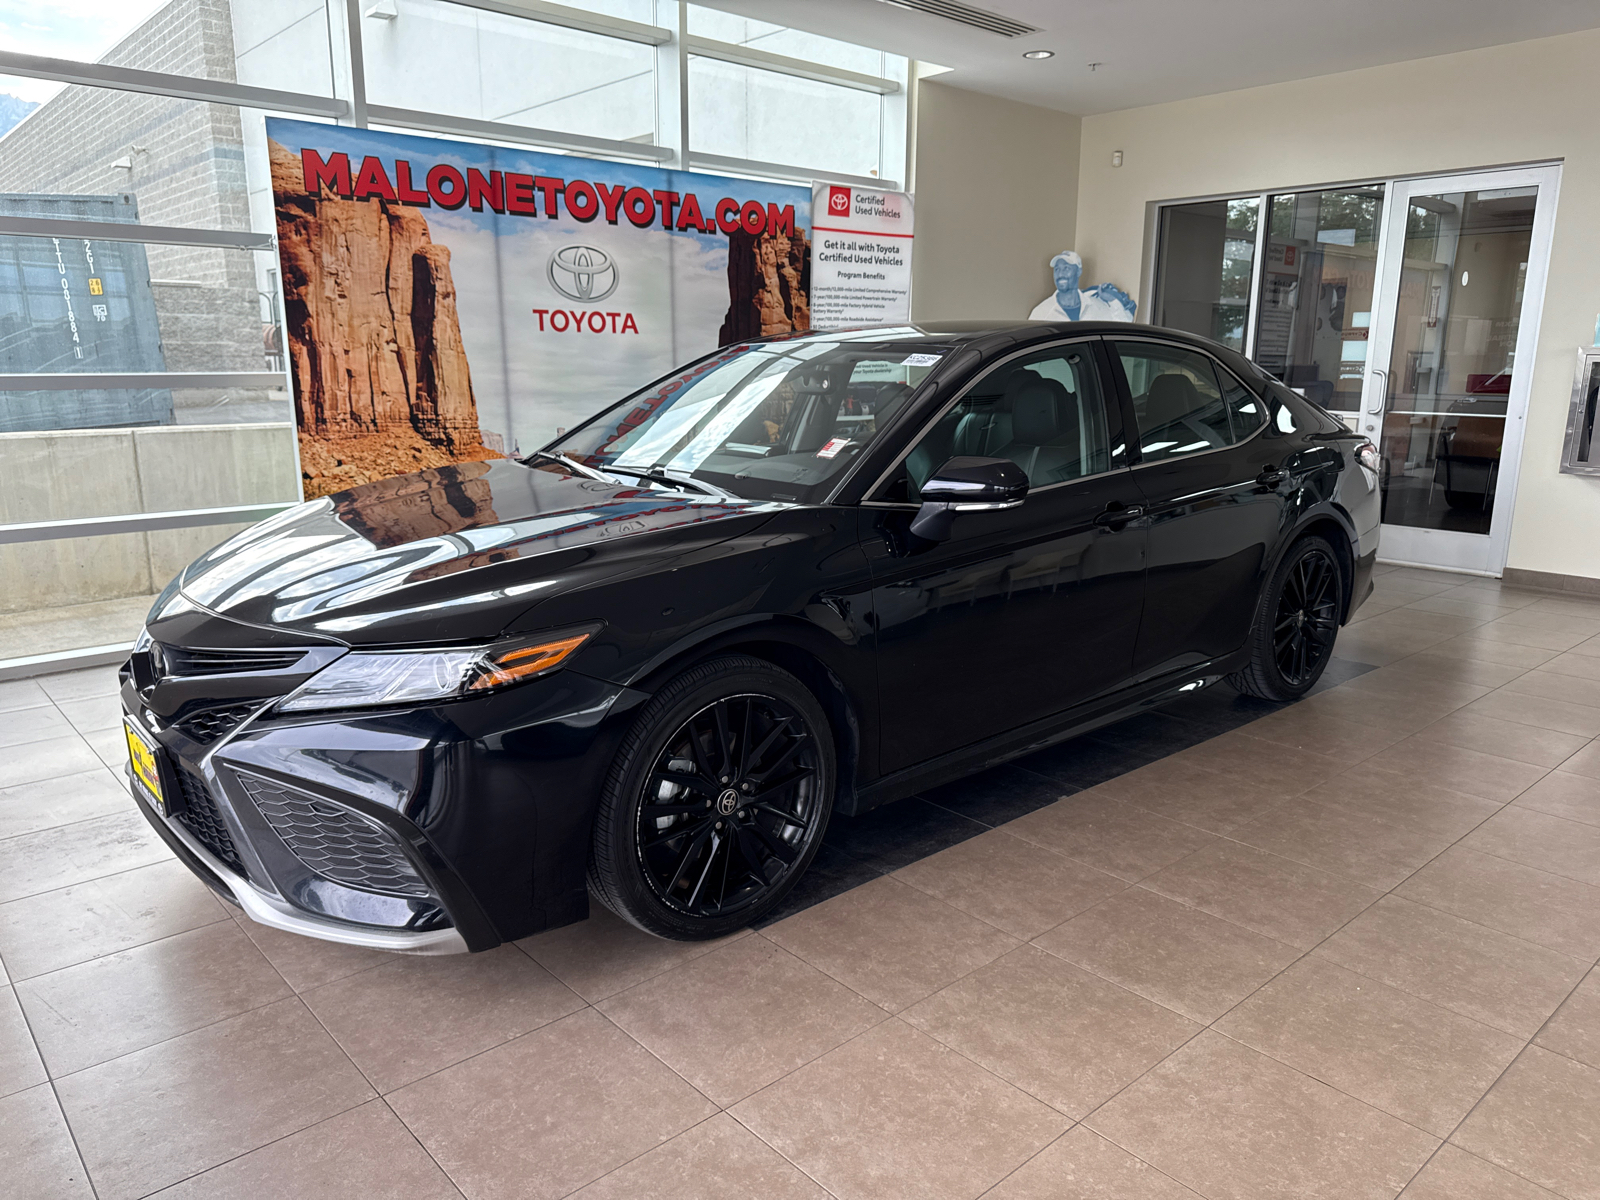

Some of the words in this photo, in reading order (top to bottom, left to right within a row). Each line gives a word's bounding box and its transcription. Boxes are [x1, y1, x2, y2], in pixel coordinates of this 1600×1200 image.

[301, 148, 795, 238] MALONETOYOTA.COM
[855, 194, 885, 206] Certified
[855, 205, 873, 216] Used
[874, 207, 901, 219] Vehicles
[824, 240, 839, 250] Get
[840, 241, 846, 250] it
[847, 241, 857, 251] all
[858, 242, 875, 252] with
[876, 244, 900, 255] Toyota
[53, 237, 66, 275] TTU
[819, 252, 853, 263] Certified
[854, 254, 873, 264] Used
[874, 255, 903, 266] Vehicles
[837, 271, 862, 281] Program
[863, 271, 885, 281] Benefits
[532, 309, 639, 335] TOYOTA
